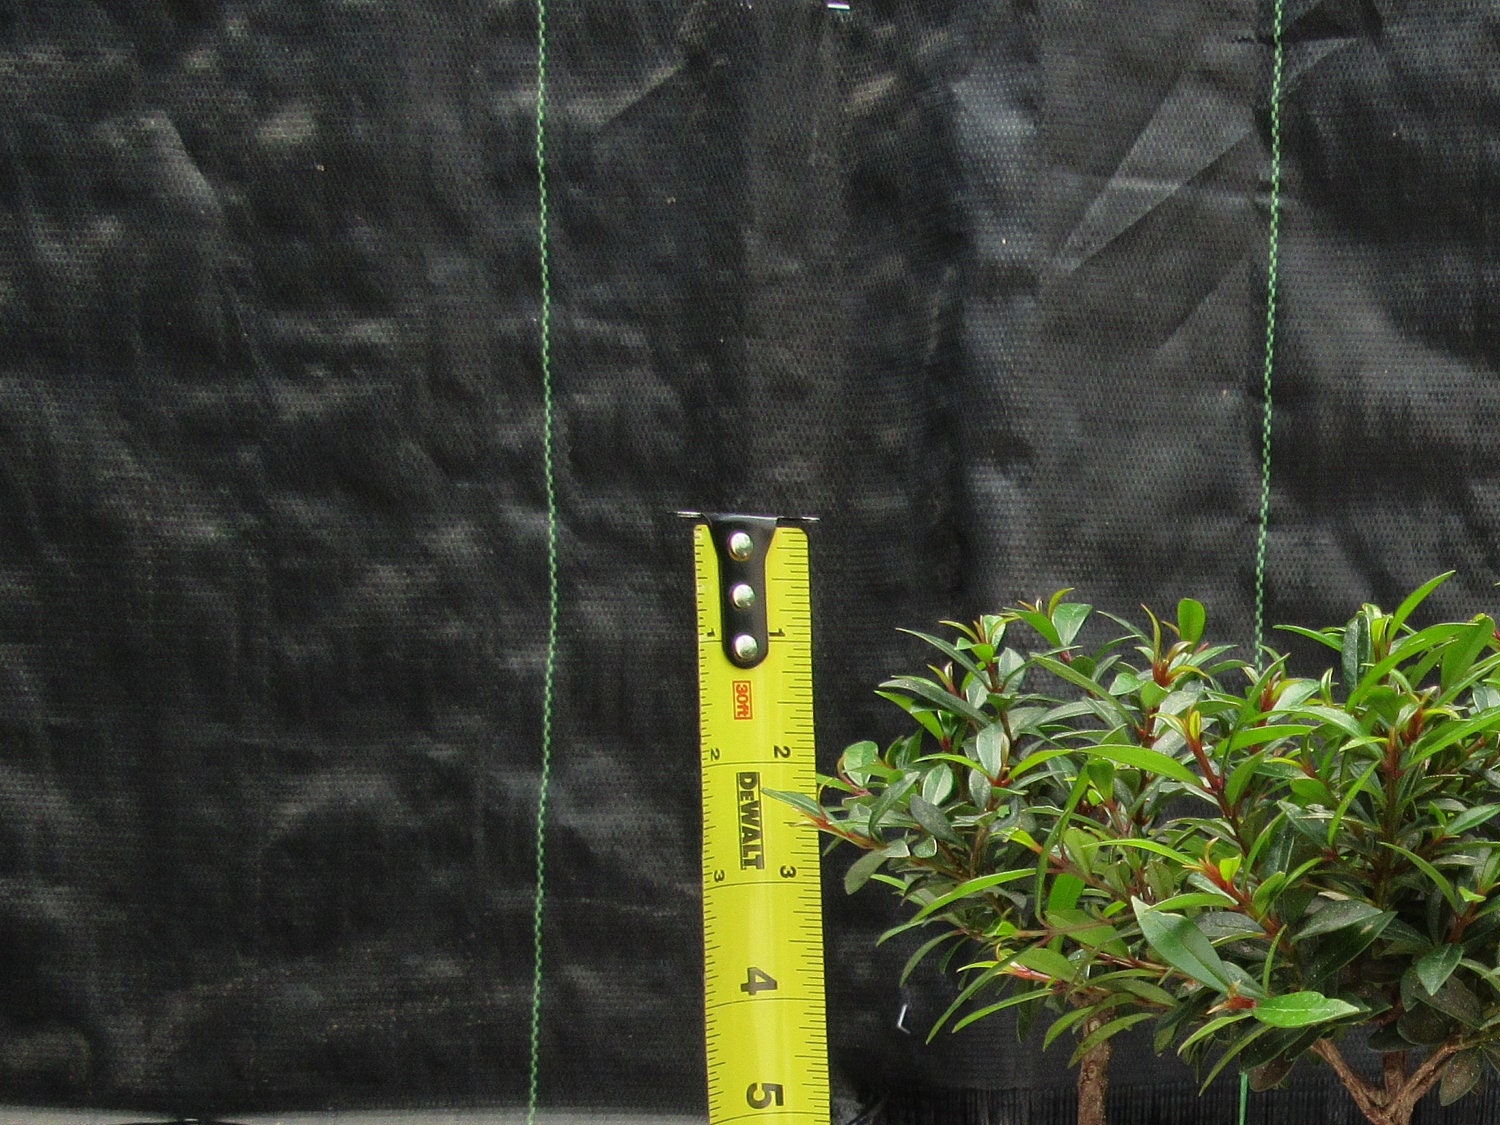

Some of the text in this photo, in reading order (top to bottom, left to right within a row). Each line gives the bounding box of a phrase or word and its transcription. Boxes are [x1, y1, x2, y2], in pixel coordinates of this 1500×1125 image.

[769, 628, 786, 637] 1
[735, 683, 748, 717] 30ft
[711, 748, 720, 760] 2
[774, 745, 790, 758] 2
[739, 772, 763, 869] DEWALT
[714, 869, 725, 882] 3
[780, 865, 796, 878] 3
[740, 966, 778, 995] 4
[746, 1082, 783, 1110] 5
